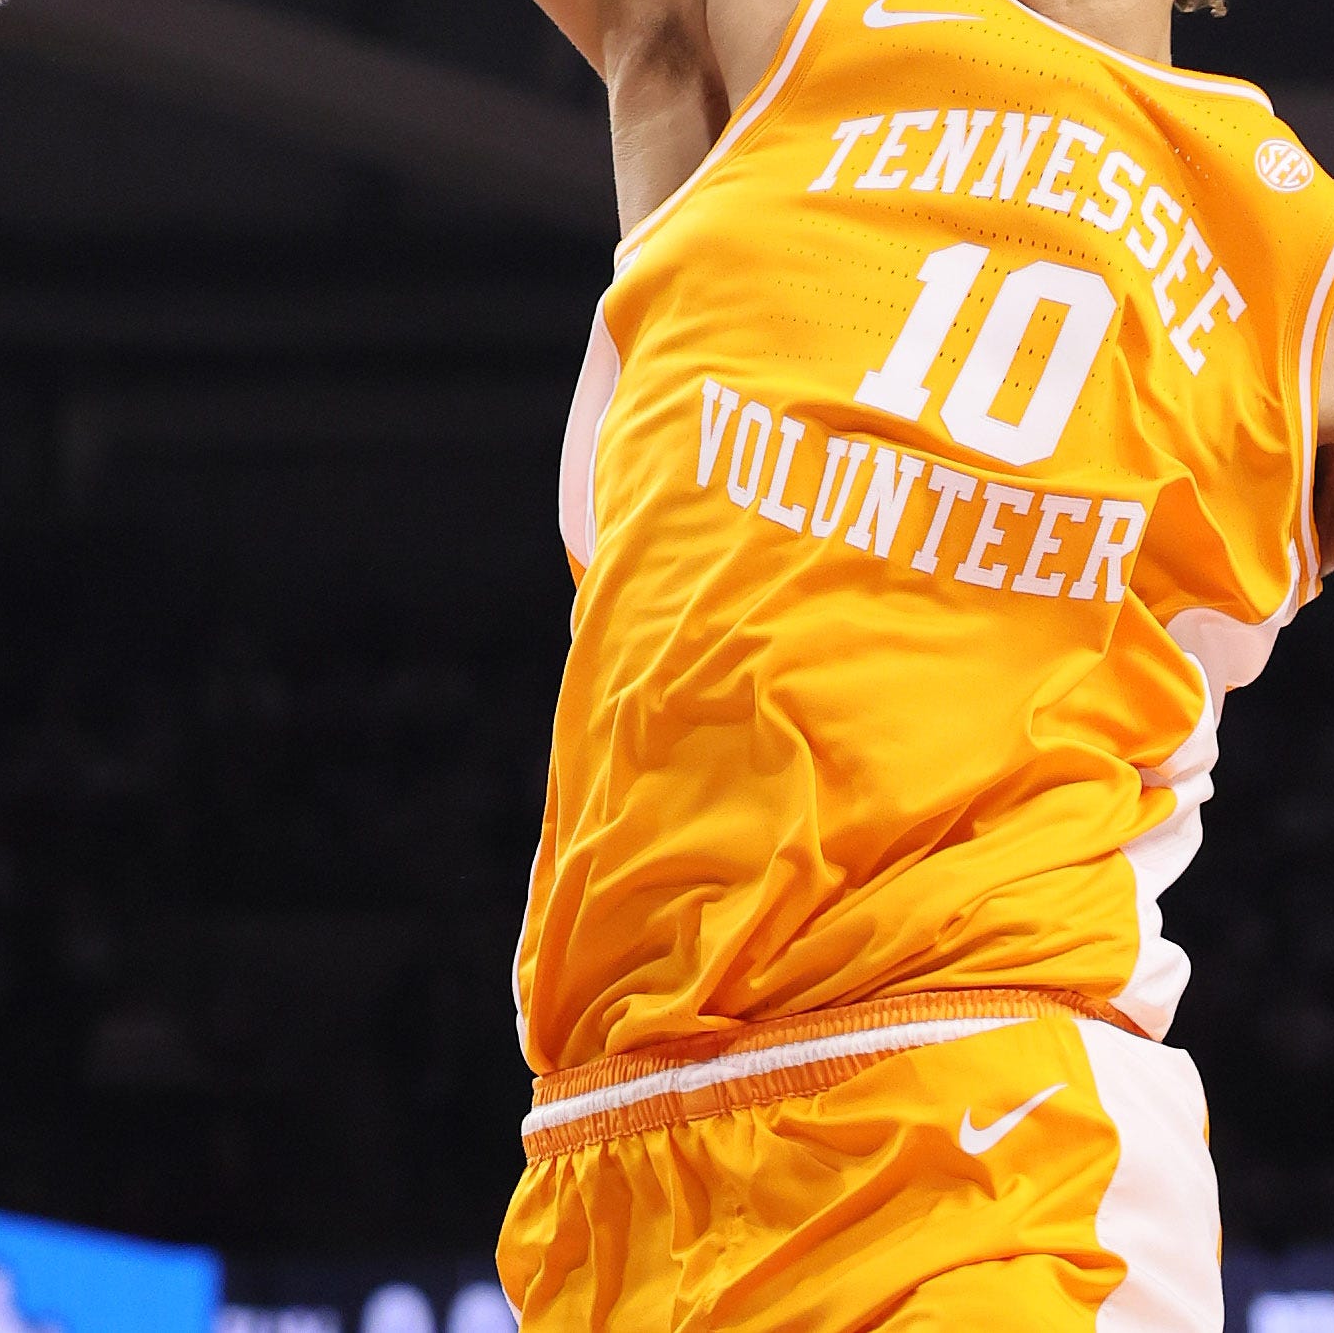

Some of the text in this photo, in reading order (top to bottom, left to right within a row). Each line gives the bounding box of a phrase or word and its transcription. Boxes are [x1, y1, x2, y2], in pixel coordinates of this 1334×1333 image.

[807, 108, 1248, 375] TENNESSEE
[1260, 145, 1309, 186] SEC
[853, 241, 1118, 467] 10
[694, 378, 1151, 604] VOLUNTEER
